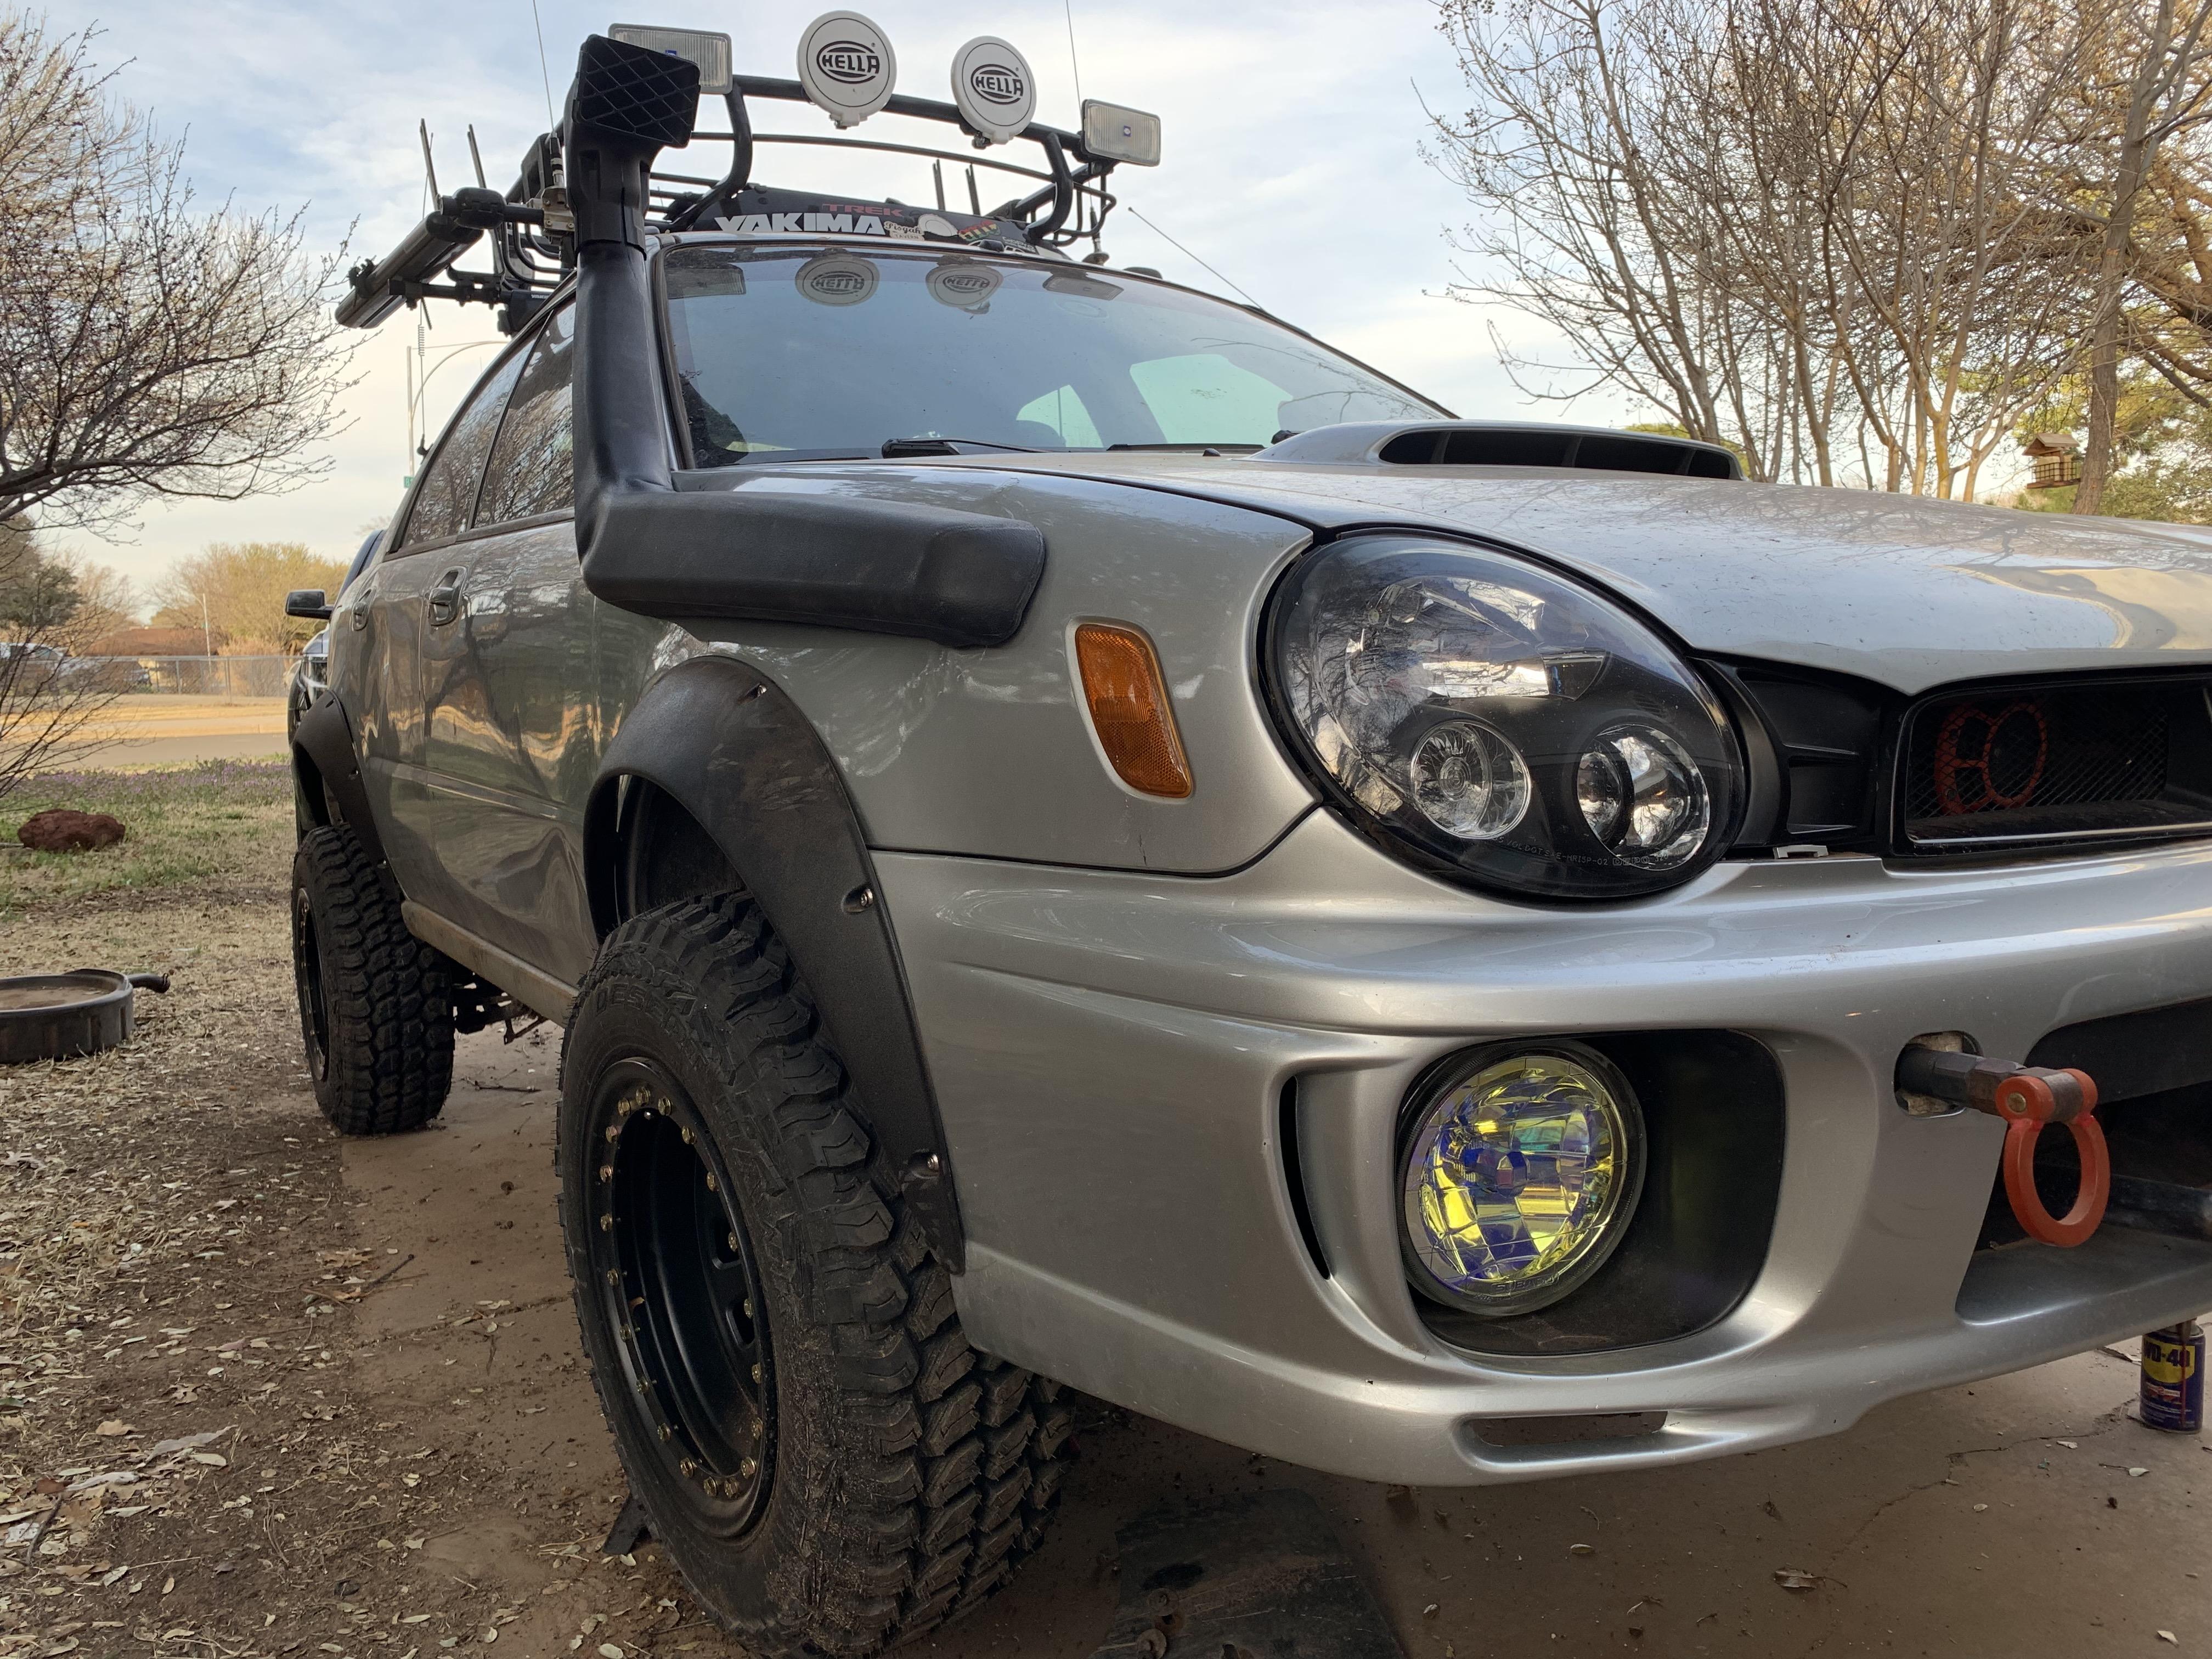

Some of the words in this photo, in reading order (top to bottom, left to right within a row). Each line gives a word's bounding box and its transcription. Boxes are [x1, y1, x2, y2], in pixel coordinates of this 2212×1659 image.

[822, 54, 880, 74] HELLA
[975, 76, 1024, 97] HELLA
[823, 204, 904, 217] TREK
[714, 212, 886, 235] YAKIMA
